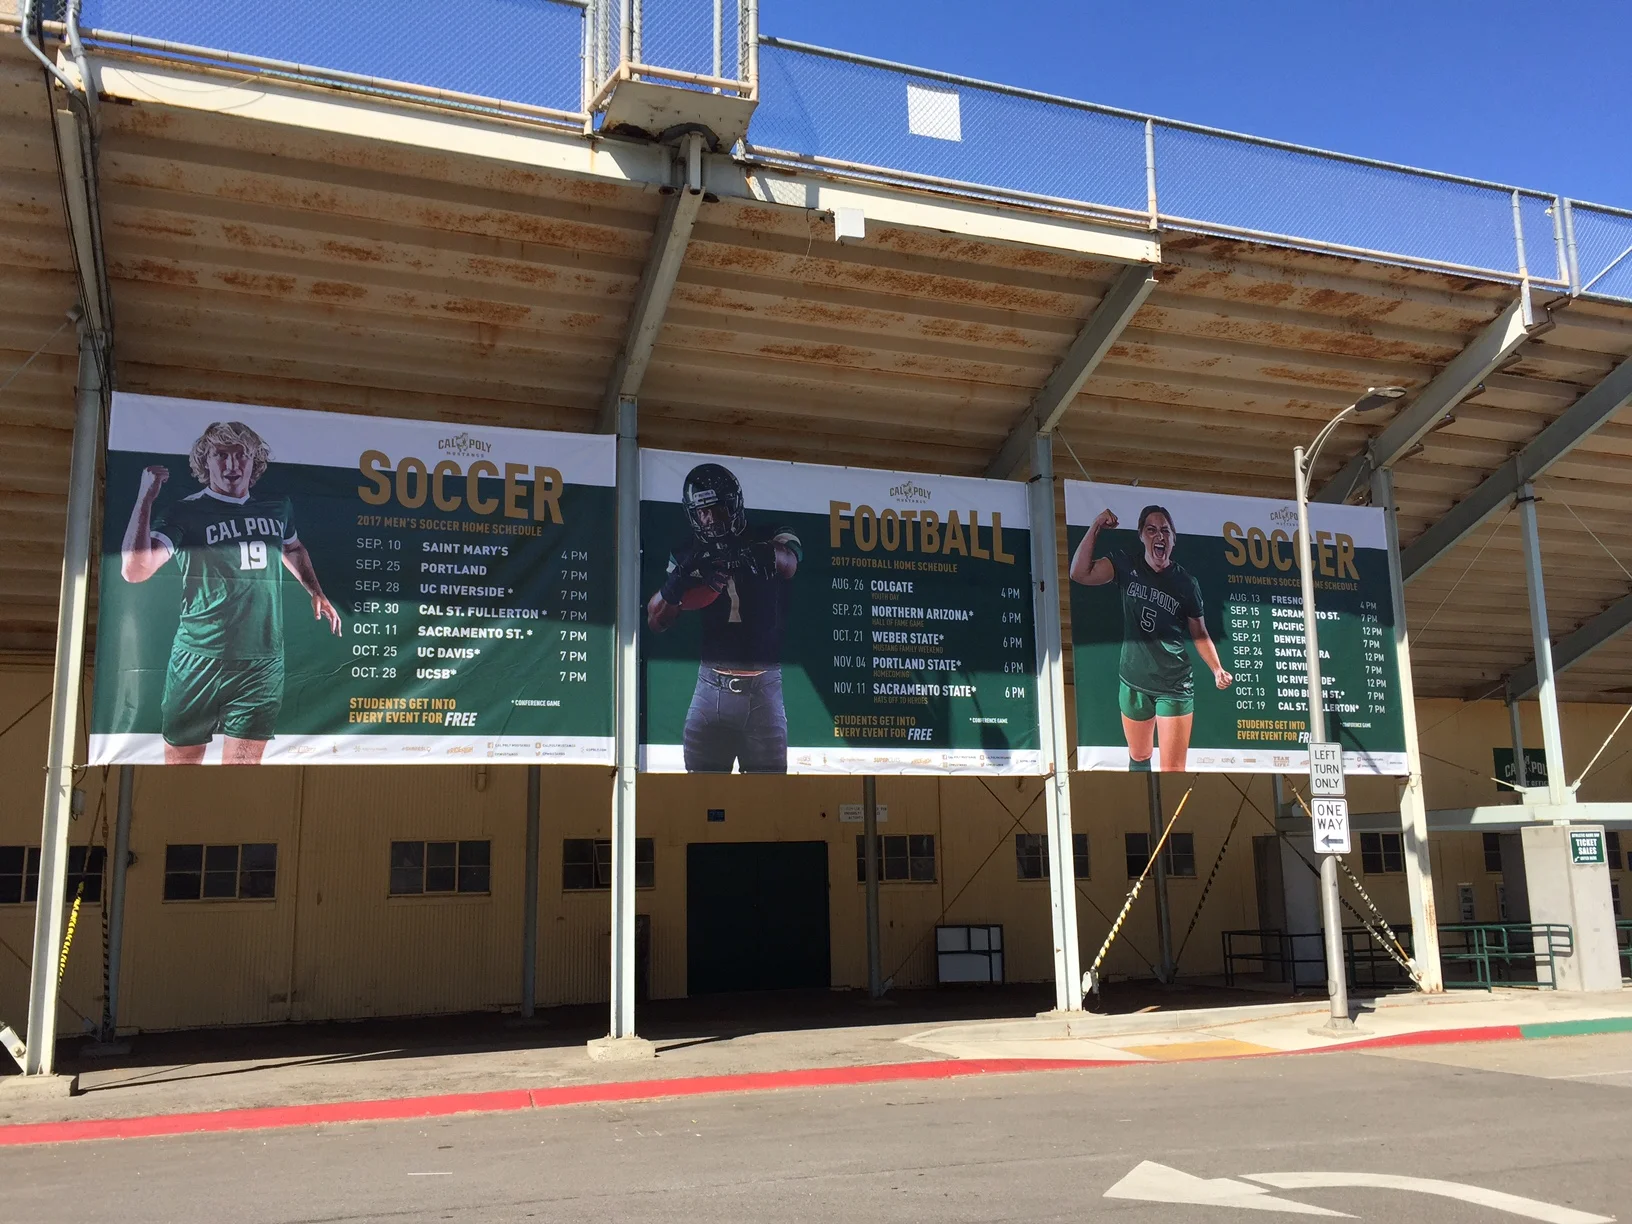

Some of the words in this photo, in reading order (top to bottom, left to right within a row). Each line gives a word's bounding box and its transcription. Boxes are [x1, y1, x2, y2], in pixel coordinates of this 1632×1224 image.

[438, 439, 456, 450] CAL
[469, 439, 491, 453] POLY
[358, 449, 564, 524] SOCCER
[889, 487, 904, 496] CAL
[913, 486, 931, 499] POLY
[1270, 511, 1281, 521] CAL
[206, 519, 241, 545] CAL
[244, 517, 284, 538] POLY
[357, 515, 382, 526] 2017
[384, 516, 417, 528] MEN'S
[419, 519, 460, 531] SOCCER
[462, 522, 490, 533] HOME
[492, 524, 542, 537] SCHEDULE
[829, 500, 1015, 565] FOOTBALL
[356, 538, 383, 550] SEP.
[388, 540, 401, 550] 10
[422, 542, 460, 554] SAINT
[463, 544, 509, 556] MARY'S
[1222, 521, 1360, 580] SOCCER
[238, 540, 268, 570] 19
[355, 559, 383, 570] SEP.
[386, 560, 401, 571] 25
[420, 563, 487, 576] PORTLAND
[831, 556, 850, 567] 2017
[852, 558, 892, 569] FOOTBALL
[893, 560, 916, 571] HOME
[917, 562, 958, 573] SCHEDULE
[355, 580, 382, 592] SEP.
[386, 582, 400, 592] 28
[420, 584, 436, 594] UC
[440, 584, 505, 597] RIVERSIDE
[832, 578, 852, 590] AUG.
[854, 579, 864, 590] 26
[870, 579, 914, 593] COLGATE
[1227, 574, 1243, 583] 2017
[1245, 575, 1278, 586] WOMEN'S
[1324, 580, 1358, 591] SCHEDULE
[1127, 581, 1148, 600] CAL
[1149, 587, 1180, 615] POLY
[1229, 593, 1249, 603] AUG.
[1251, 594, 1260, 603] 13
[1271, 596, 1303, 605] FRESNO
[354, 602, 382, 613] SEP.
[384, 603, 399, 614] 30
[419, 604, 443, 616] CAL
[446, 606, 465, 617] ST.
[468, 607, 539, 619] FULLERTON
[832, 603, 850, 616] SEP.
[852, 604, 863, 616] 23
[871, 605, 924, 619] NORTHERN
[1230, 606, 1248, 615] SEP.
[1250, 607, 1260, 616] 15
[1271, 608, 1327, 620] SACRAMTO
[1328, 612, 1340, 621] ST.
[872, 619, 886, 627] HALL
[888, 619, 894, 627] OF
[909, 620, 924, 628] GAME
[1140, 606, 1157, 633] 5
[1231, 619, 1249, 629] SEP.
[1251, 620, 1260, 629] 17
[1273, 622, 1304, 631] PACIFIC
[353, 623, 380, 635] OCT.
[385, 624, 397, 635] 11
[418, 626, 504, 639] SACRAMENTO
[505, 629, 524, 639] ST.
[833, 630, 851, 642] OCT.
[853, 630, 863, 642] 21
[872, 631, 908, 644] WEBER
[1232, 633, 1250, 642] SEP.
[1251, 634, 1261, 642] 21
[1274, 634, 1306, 644] DENVER
[352, 645, 380, 656] OCT.
[383, 646, 397, 657] 25
[418, 647, 434, 658] UC
[872, 644, 899, 652] MUSTANG
[899, 644, 918, 653] FAMILY
[918, 645, 944, 654] WEEKEND
[1233, 646, 1251, 655] SEP.
[1252, 647, 1263, 656] 24
[1274, 648, 1302, 657] SANTA
[833, 656, 854, 668] NOV.
[855, 656, 866, 668] 04
[872, 657, 925, 670] PORTLAND
[1234, 660, 1252, 669] SEP.
[1253, 660, 1263, 669] 29
[1276, 661, 1288, 670] UC
[351, 667, 379, 678] OCT.
[382, 668, 397, 678] 28
[873, 670, 910, 678] HOMECOMING
[1235, 673, 1253, 682] OCT.
[1277, 675, 1289, 684] UC
[834, 682, 854, 694] NOV.
[856, 682, 866, 694] 11
[873, 683, 940, 697] SACRAMENTO
[1236, 687, 1254, 696] OCT.
[1256, 688, 1265, 696] 13
[1277, 688, 1299, 697] LONG
[349, 697, 406, 709] STUDENTS
[409, 698, 429, 710] GET
[431, 698, 456, 710] INTO
[515, 699, 546, 707] CONFERENCE
[873, 696, 888, 704] HATS
[888, 696, 899, 704] OFF
[907, 697, 928, 705] HEROES
[1236, 701, 1255, 710] OCT.
[1256, 702, 1266, 710] 19
[1278, 702, 1294, 711] CAL
[1295, 702, 1308, 711] ST.
[349, 711, 384, 723] EVERY
[386, 711, 420, 723] EVENT
[422, 712, 443, 724] FOR
[444, 712, 478, 727] FREE
[834, 715, 878, 726] STUDENTS
[879, 716, 895, 726] GET
[896, 716, 916, 726] INTO
[1237, 719, 1274, 730] STUDENTS
[1275, 720, 1288, 730] GET
[1289, 720, 1305, 730] INTO
[834, 727, 860, 738] EVERY
[862, 727, 889, 738] EVENT
[890, 727, 907, 738] FOR
[907, 728, 933, 741] FREE
[1237, 731, 1260, 740] EVERY
[1260, 731, 1283, 741] EVENT
[1284, 731, 1297, 741] FOR
[1314, 750, 1336, 761] LEFT
[1314, 763, 1340, 774] TURN
[1505, 763, 1517, 778] CA
[1531, 761, 1549, 777] POL
[1315, 778, 1340, 789] ONLY
[1317, 804, 1342, 816] ONE
[1317, 818, 1343, 831] WAY
[1575, 838, 1598, 847] TICKET
[1578, 846, 1598, 855] SALES
